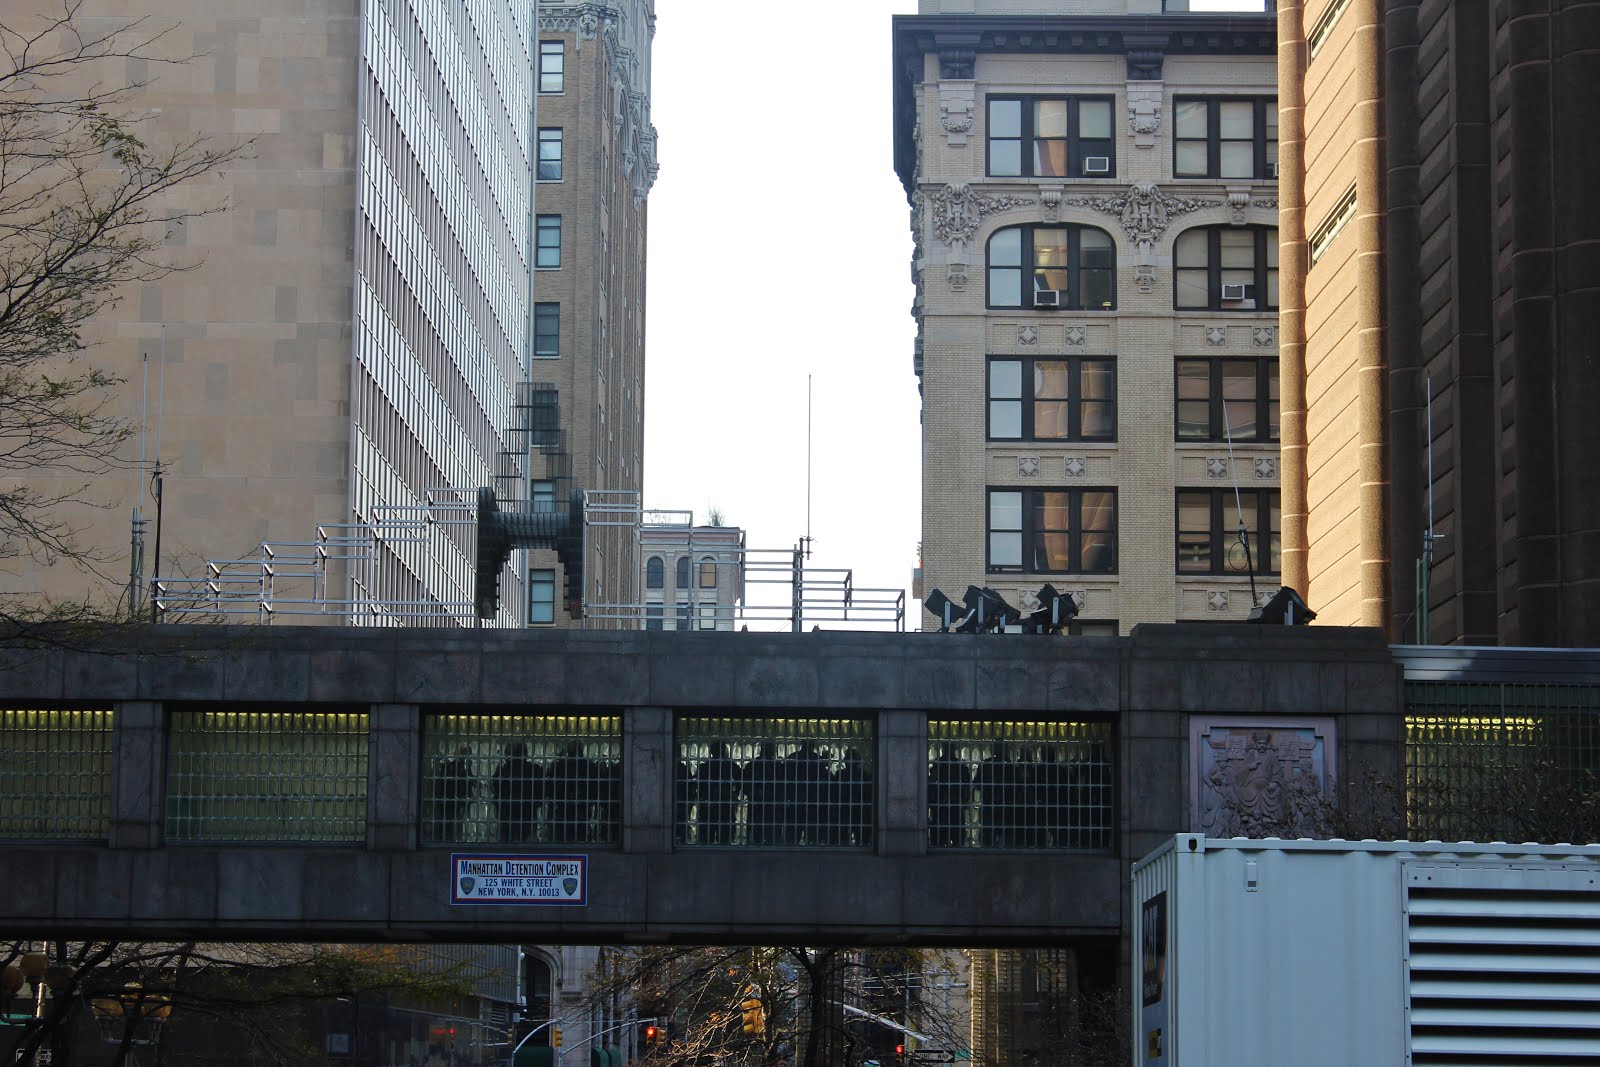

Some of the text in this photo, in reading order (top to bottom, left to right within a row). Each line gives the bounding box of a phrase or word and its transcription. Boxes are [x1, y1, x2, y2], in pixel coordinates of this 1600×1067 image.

[461, 861, 579, 876] MANHATTAN DETENTION COMPLEX
[485, 878, 553, 888] 125 WHITE STREET
[478, 887, 560, 897] NEW YORK, N.Y. 10013
